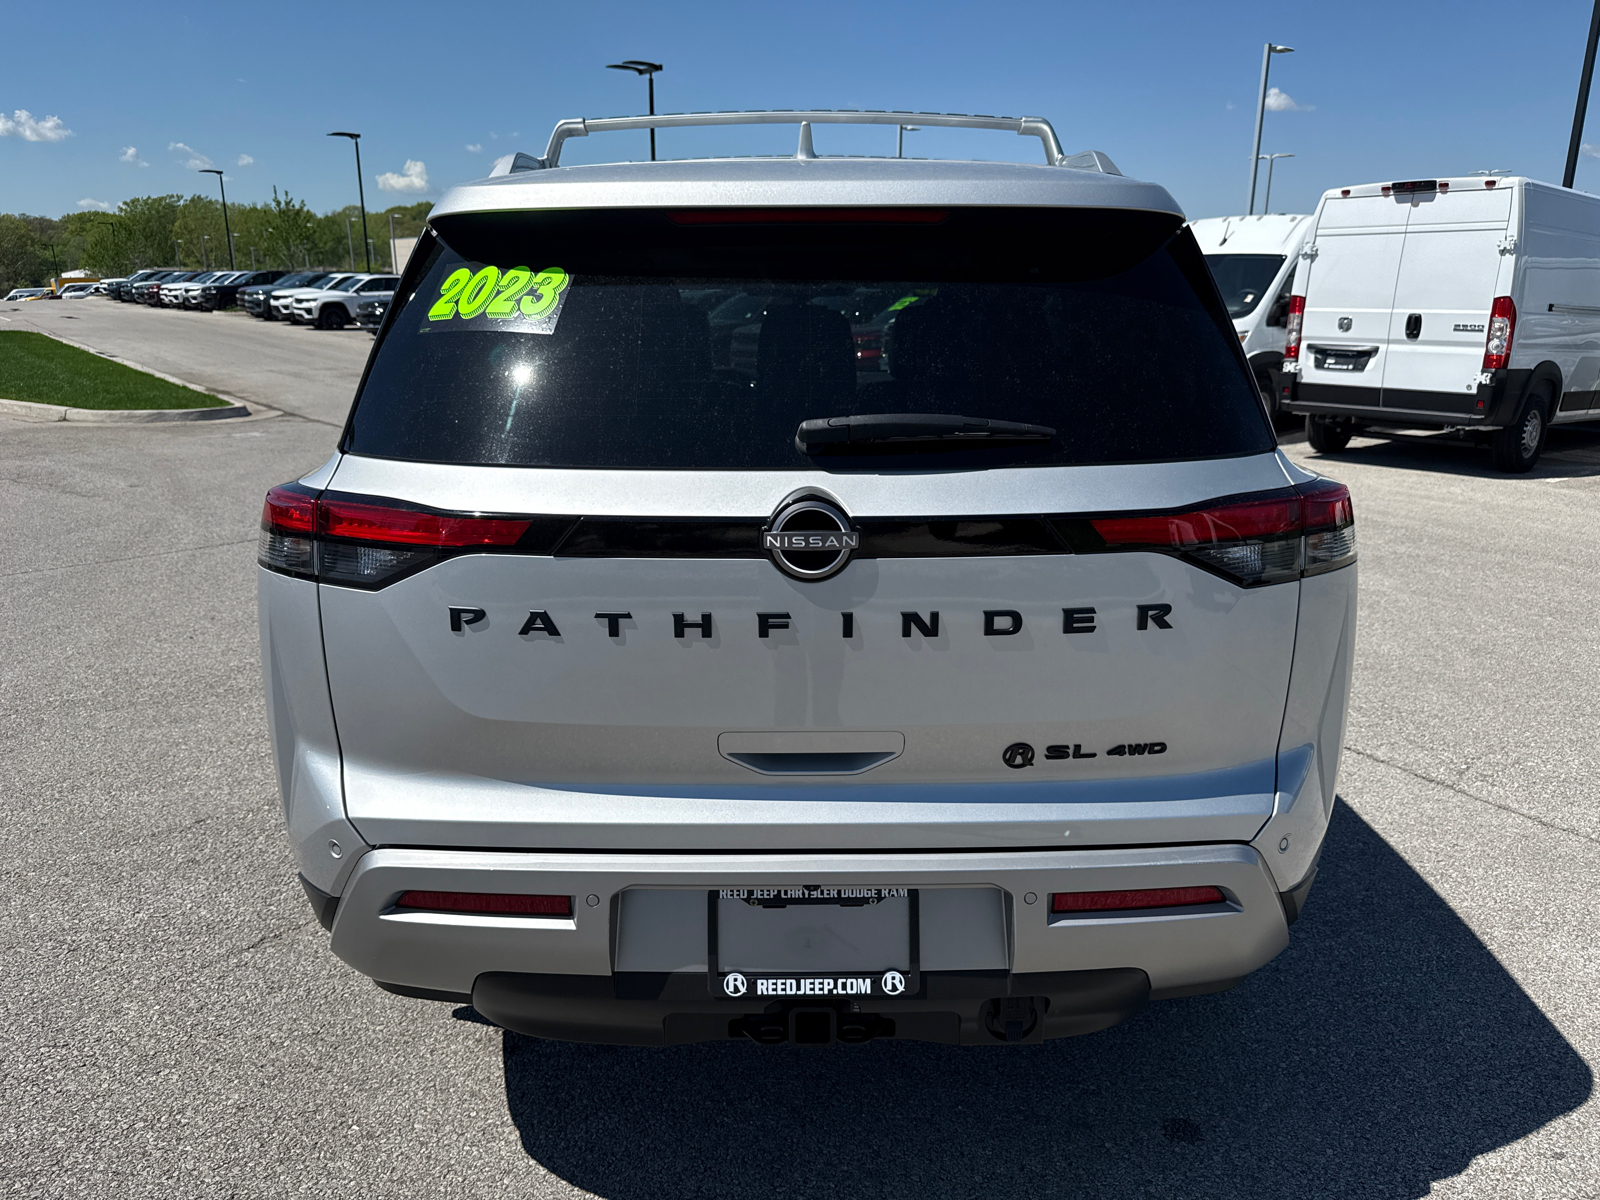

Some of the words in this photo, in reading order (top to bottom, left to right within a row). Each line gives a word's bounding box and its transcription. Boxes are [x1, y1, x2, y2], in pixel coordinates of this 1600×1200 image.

[428, 265, 569, 321] 2023
[766, 535, 856, 548] NISSAN
[448, 603, 1173, 639] PATHFINDER
[1044, 744, 1097, 760] SL
[1106, 742, 1167, 757] 4WD
[720, 888, 748, 899] REED
[751, 888, 778, 899] JEEP
[781, 888, 838, 898] CHRYSLER
[841, 888, 878, 898] DODGE
[881, 888, 908, 898] RAM
[757, 978, 871, 995] REEDJEEP.COM
